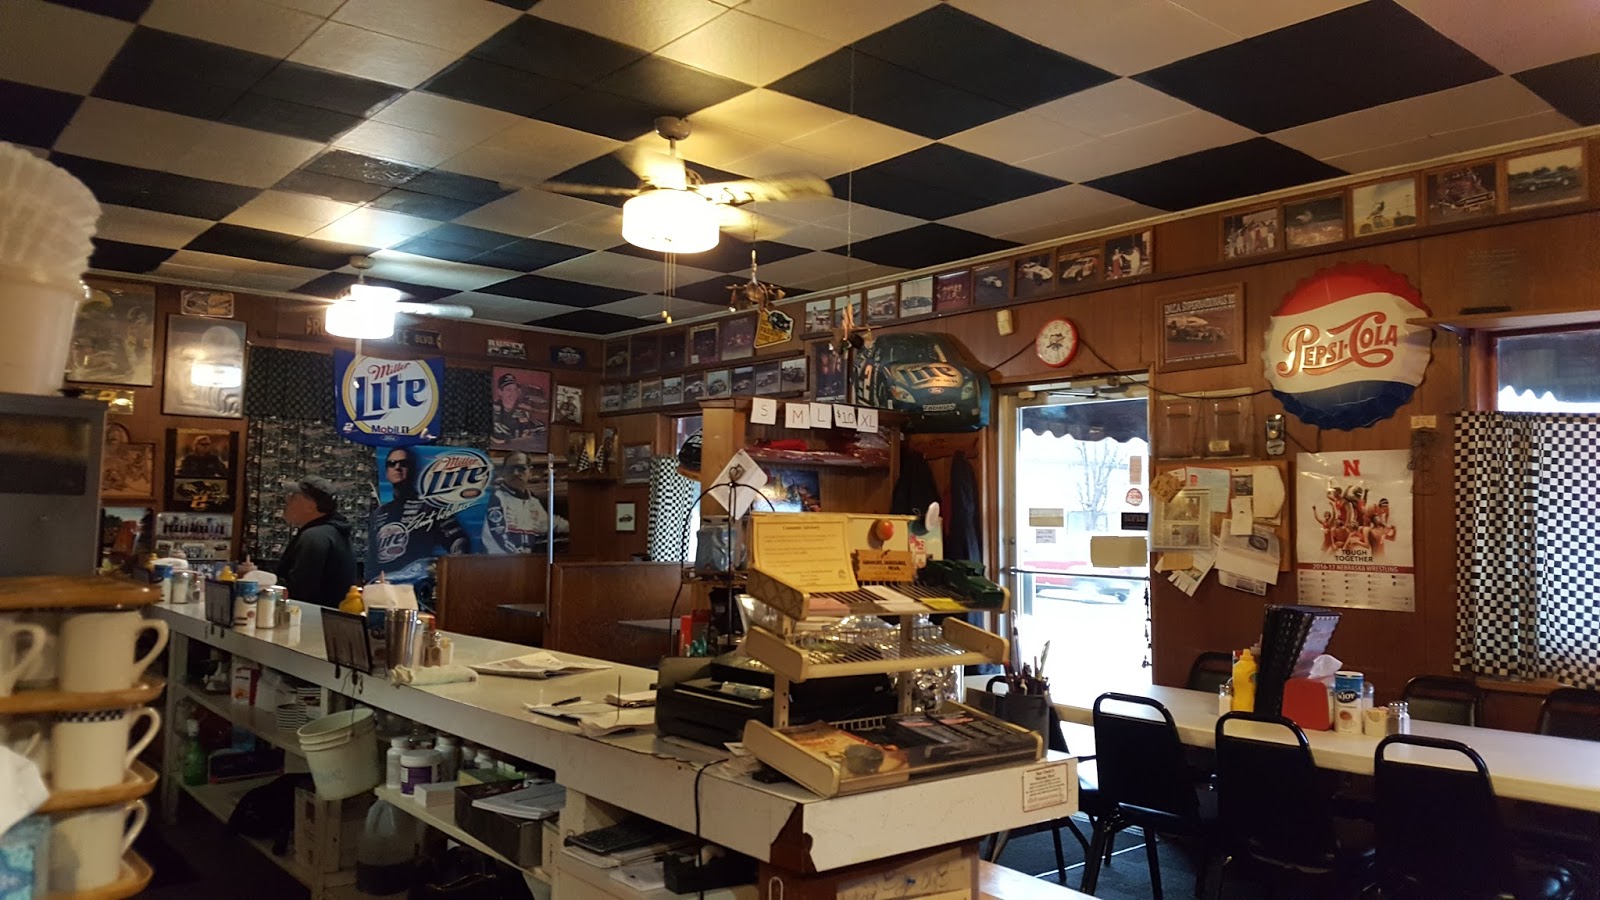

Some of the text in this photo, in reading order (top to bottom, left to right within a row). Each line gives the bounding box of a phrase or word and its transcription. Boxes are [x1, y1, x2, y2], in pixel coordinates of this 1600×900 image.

[368, 362, 411, 380] Miller
[353, 374, 428, 421] Lite
[760, 404, 768, 417] S
[792, 409, 804, 424] M
[817, 407, 826, 422] L
[836, 410, 855, 424] $10
[861, 414, 876, 428] XL
[371, 425, 398, 434] Mobil
[442, 456, 479, 470] Miller
[1343, 459, 1360, 477] N
[424, 465, 490, 497] Lite
[1335, 555, 1374, 563] TOGETHER
[1312, 563, 1336, 571] 2016-17
[1336, 564, 1366, 572] NEBRASKA
